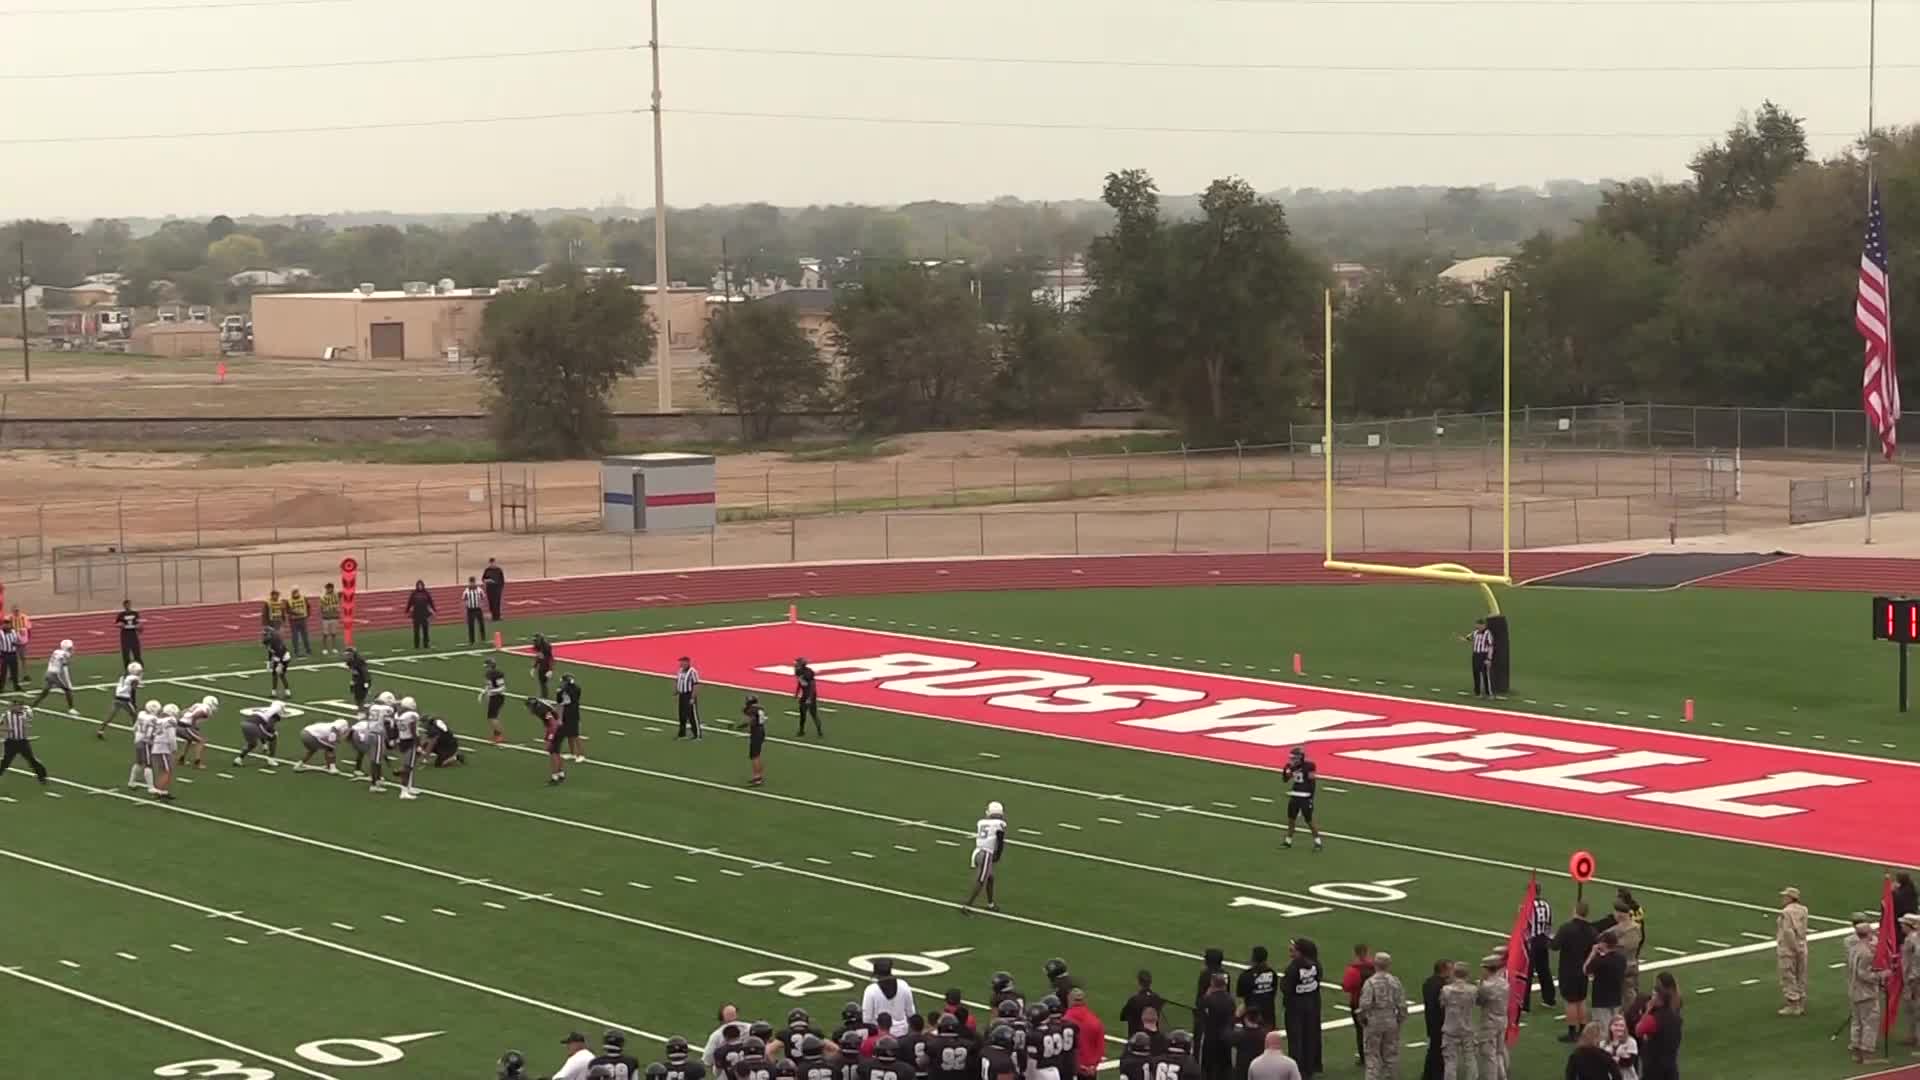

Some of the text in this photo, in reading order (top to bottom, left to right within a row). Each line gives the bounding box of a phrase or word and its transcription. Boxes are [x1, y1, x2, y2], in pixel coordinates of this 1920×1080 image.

[753, 652, 1869, 819] ROSWELL
[1227, 882, 1408, 918] 10
[737, 953, 951, 998] 20
